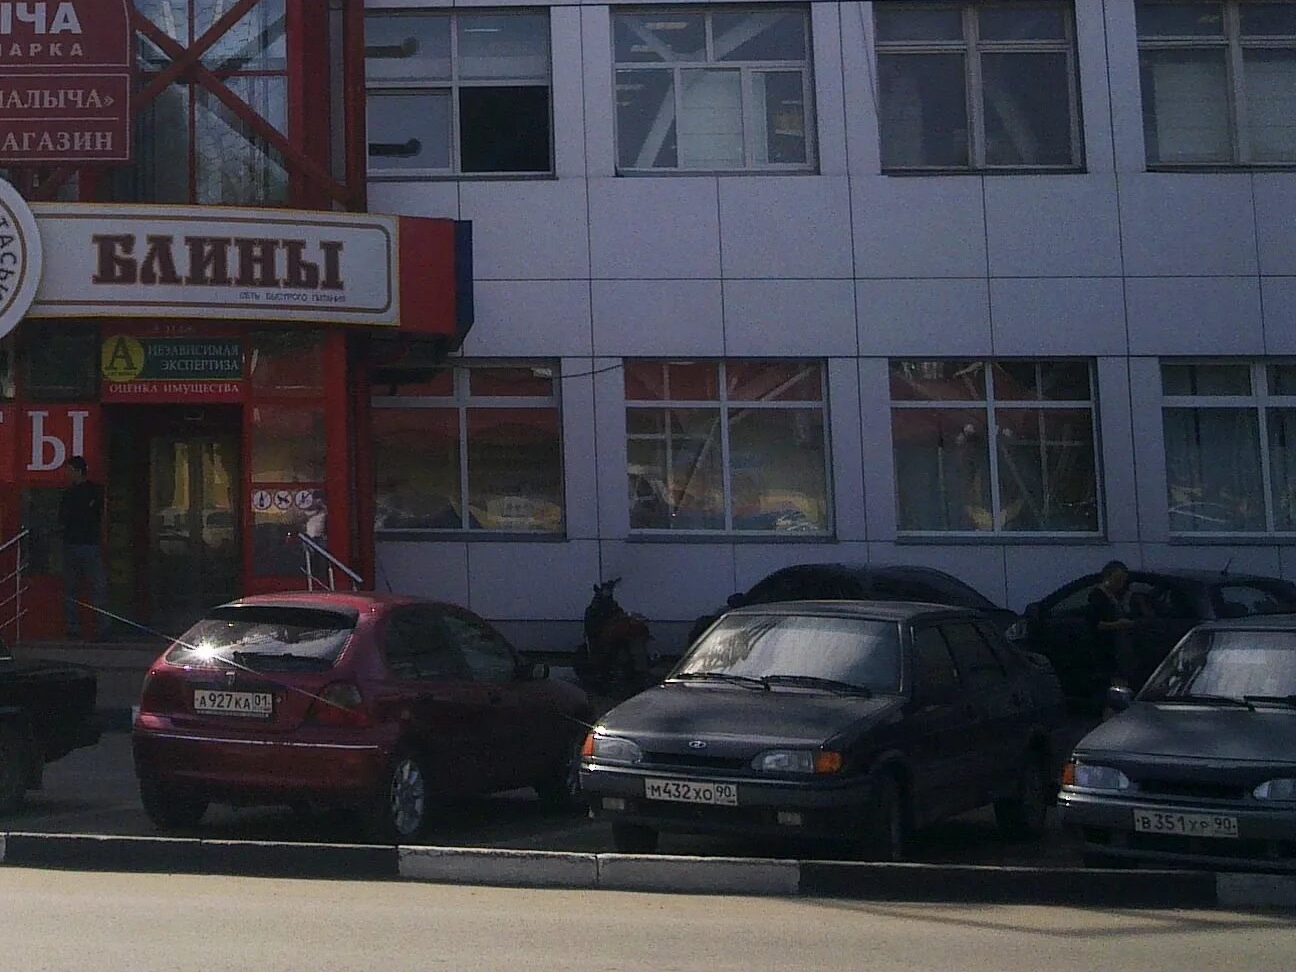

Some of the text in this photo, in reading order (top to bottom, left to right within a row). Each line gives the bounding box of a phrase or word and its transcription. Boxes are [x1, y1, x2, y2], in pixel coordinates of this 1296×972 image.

[91, 233, 345, 290] БЛИНЫ
[148, 344, 239, 357] НЕЗАВИСИМАЯ
[160, 359, 239, 372] ЭКСПЕРТИЗА
[109, 383, 239, 395] ОЦЕНКА ИМУЩЕСТВА
[198, 692, 251, 710] А927КА
[650, 782, 713, 801] М432ХО
